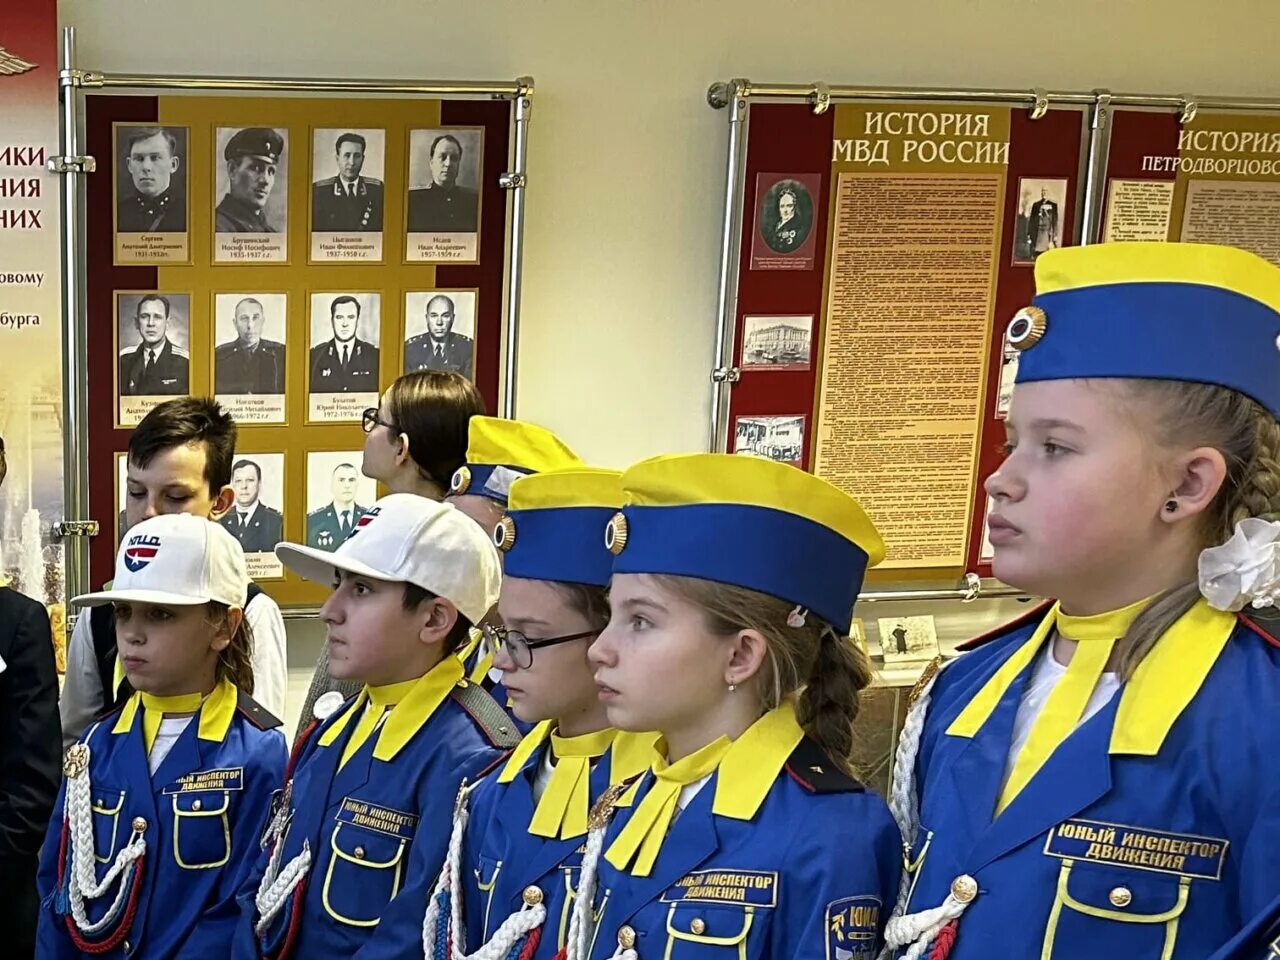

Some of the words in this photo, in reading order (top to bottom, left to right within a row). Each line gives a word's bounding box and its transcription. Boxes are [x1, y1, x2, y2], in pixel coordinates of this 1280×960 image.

[864, 111, 991, 137] ИСТОРИЯ
[831, 138, 889, 166] МВД
[900, 139, 1011, 166] РОССИИ
[1177, 129, 1280, 154] ИСТОРИЯ
[181, 779, 224, 791] ДВИЖЕНИЯ
[351, 813, 401, 833] ДВИЖЕНИЯ
[369, 807, 417, 827] ИНСПЕКТО
[1057, 822, 1116, 845] ЮНЫЙ
[1121, 832, 1220, 859] ИНСПЕКТОР
[1085, 843, 1186, 871] ДВИЖЕНИЯ
[705, 873, 773, 889] ИНСПЕКТОР
[683, 886, 746, 901] ДВИЖЕНИЯ
